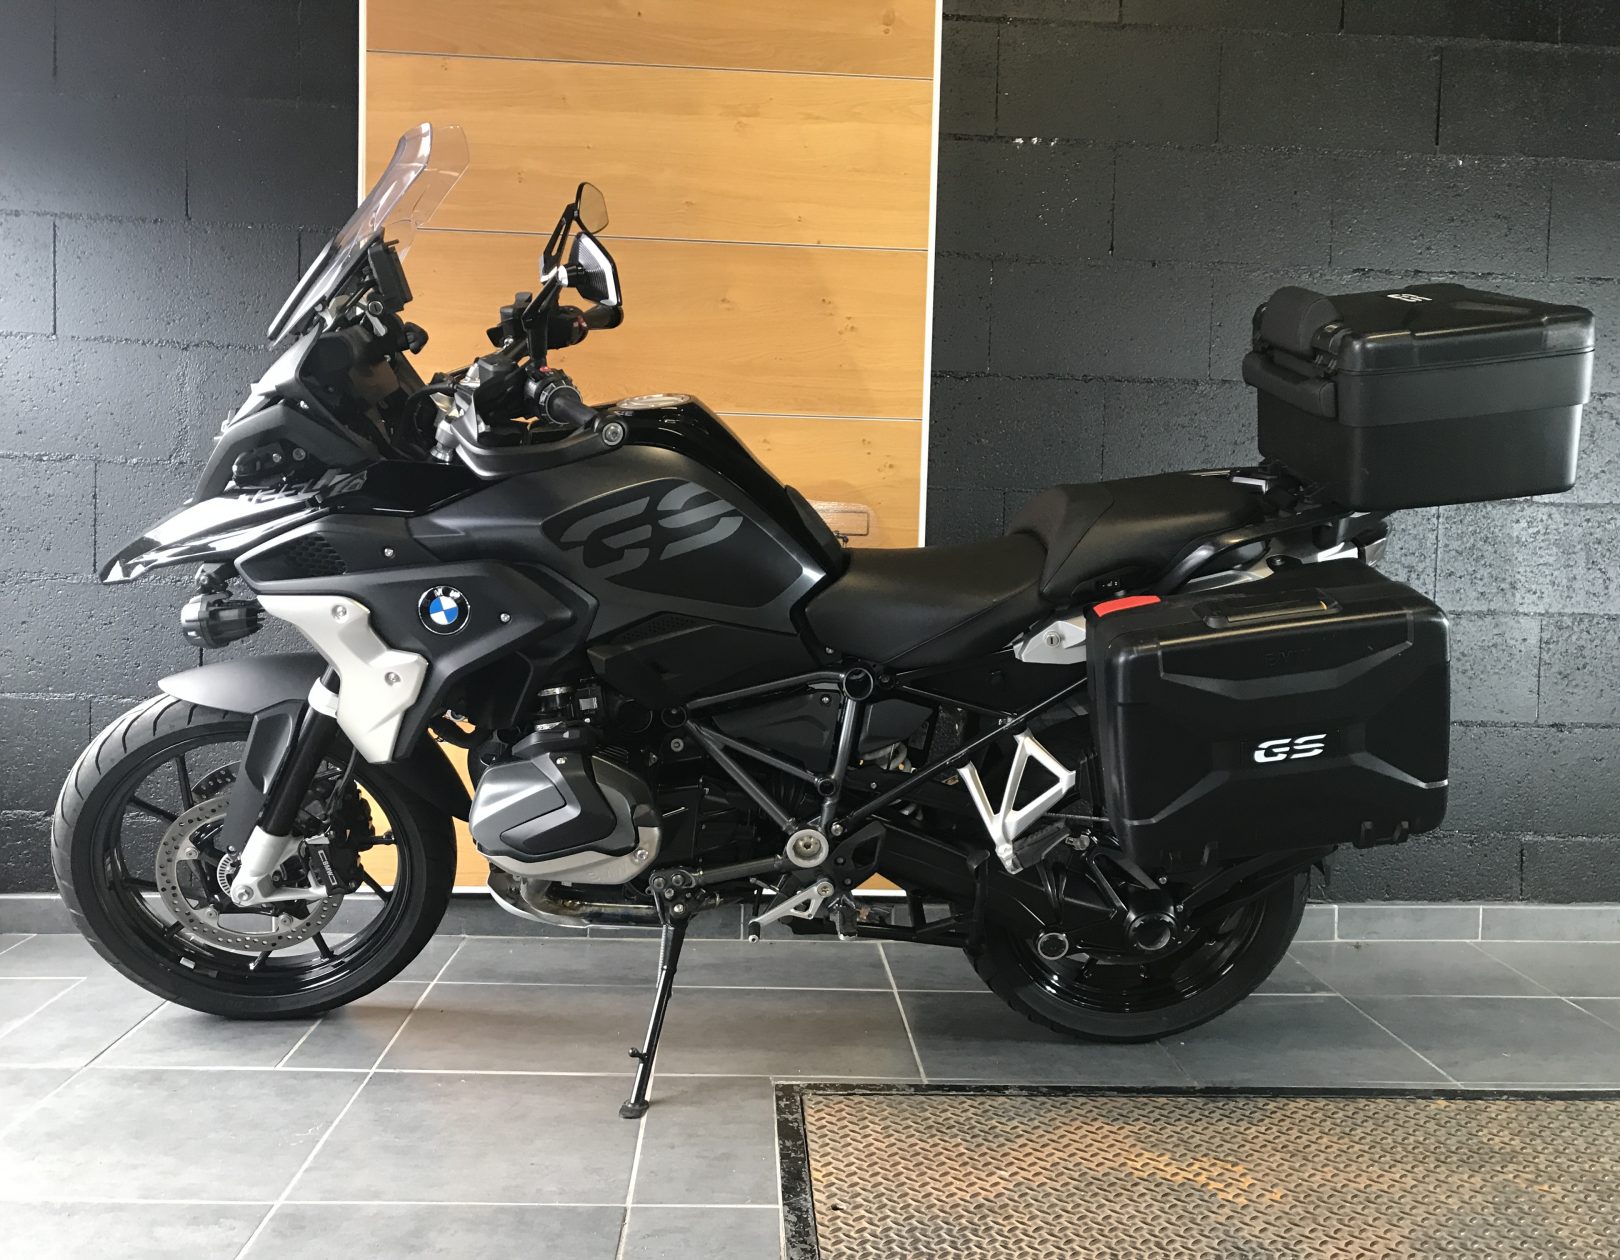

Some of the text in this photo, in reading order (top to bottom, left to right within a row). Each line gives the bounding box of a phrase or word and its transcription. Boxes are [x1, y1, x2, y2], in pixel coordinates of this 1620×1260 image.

[560, 481, 744, 580] GS
[1254, 733, 1327, 763] GS
[322, 860, 334, 876] BMW
